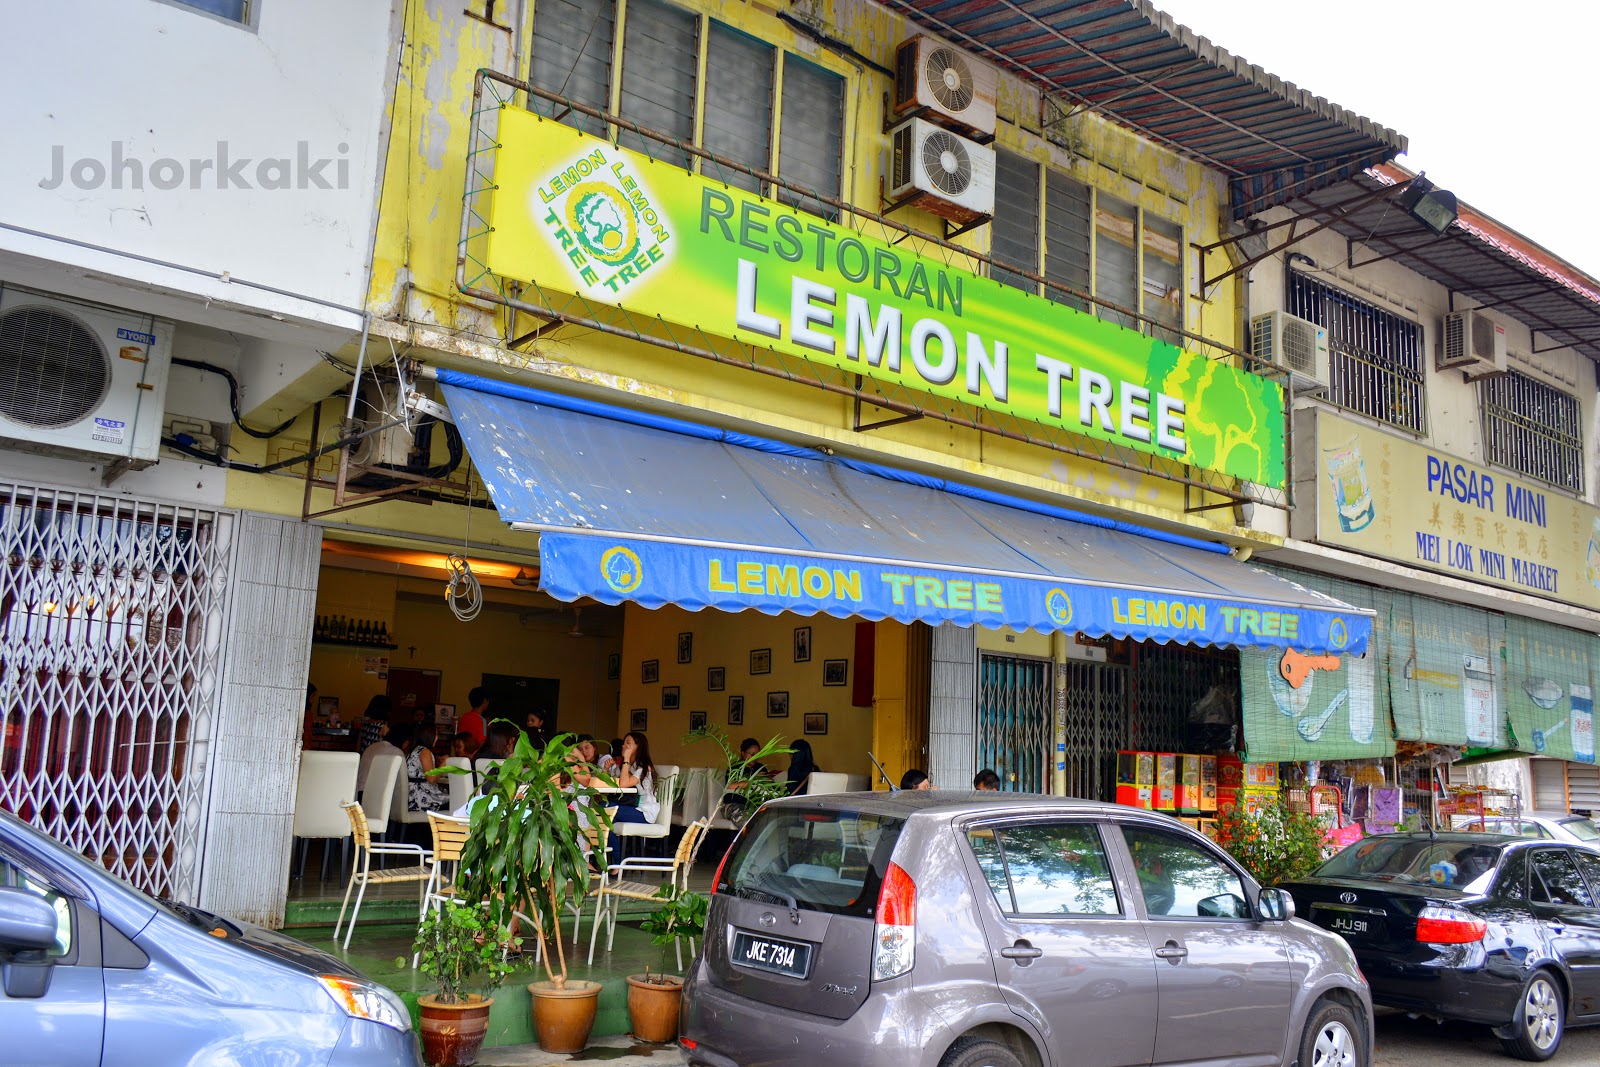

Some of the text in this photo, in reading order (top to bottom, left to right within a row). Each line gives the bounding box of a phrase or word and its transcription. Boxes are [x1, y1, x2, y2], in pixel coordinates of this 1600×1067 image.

[537, 148, 607, 204] LEMON
[610, 161, 670, 243] LEMON
[543, 207, 600, 288] TREE
[602, 243, 666, 294] TREE
[700, 186, 964, 316] RESTORAN
[127, 331, 153, 344] YORK
[736, 257, 1188, 454] LEMON TREE
[1427, 455, 1494, 512] PASAR
[1506, 483, 1547, 528] MINI
[708, 559, 1005, 613] LEMON TREE
[1416, 531, 1559, 593] MEI LOK MINI MARKET
[1111, 597, 1299, 639] LEMON TREE
[1331, 918, 1368, 932] JHJ 911
[746, 940, 796, 967] JKE 7314
